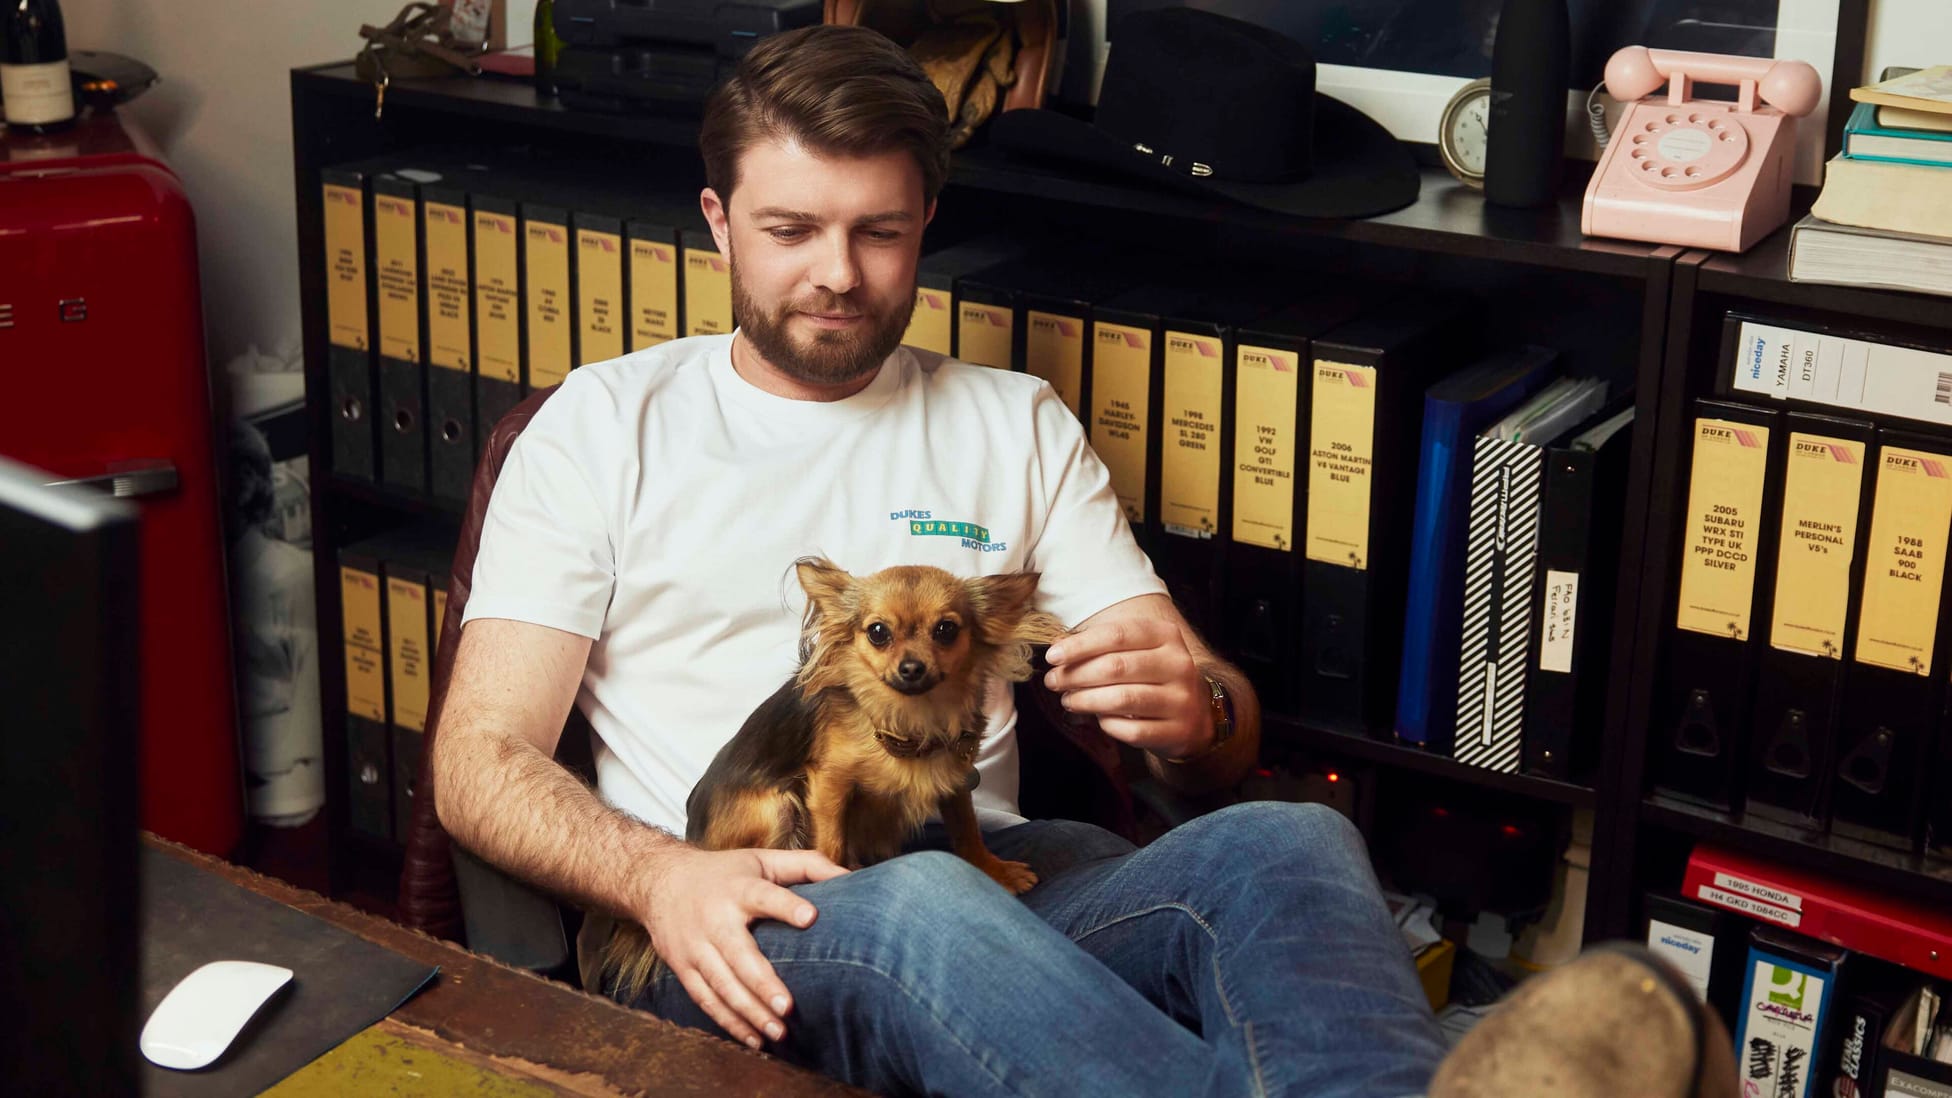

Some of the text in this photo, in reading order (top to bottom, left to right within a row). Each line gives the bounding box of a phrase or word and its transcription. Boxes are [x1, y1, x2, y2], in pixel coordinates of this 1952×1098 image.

[1170, 340, 1193, 349] DUKE
[1243, 354, 1267, 363] DUKE
[1751, 337, 1766, 380] niceday
[1776, 343, 1791, 387] YAMAHA
[1802, 350, 1814, 382] DT360
[1319, 369, 1344, 379] DUKE
[1098, 417, 1140, 431] DAVIDSON
[1171, 418, 1214, 432] MERCEDES
[1257, 425, 1276, 436] 1992
[1702, 427, 1732, 438] DUKE
[1178, 440, 1206, 451] GREEN
[1258, 436, 1273, 445] VW
[1331, 442, 1352, 452] 2006
[1254, 445, 1276, 456] GOLF
[1796, 443, 1827, 454] DUKE
[1258, 456, 1272, 465] GTI
[1312, 450, 1371, 465] ASTON MARTIN
[1886, 456, 1918, 467] DUKE
[1239, 463, 1290, 478] CONVERTIBLE
[1329, 462, 1365, 475] VANTAGE
[1255, 476, 1274, 486] BLUE
[1330, 473, 1350, 483] BLUE
[890, 509, 932, 520] DUKES
[1713, 504, 1738, 516] 2005
[1704, 514, 1745, 528] SUBARU
[1799, 519, 1842, 533] MERLIN'S
[911, 522, 988, 540] QUALITY
[1703, 525, 1744, 539] WRX STI
[1794, 530, 1844, 545] PERSONAL
[961, 538, 1007, 553] MOTORS
[1702, 536, 1742, 550] TYPE UK
[1897, 535, 1923, 548] 1988
[1694, 545, 1748, 562] PPP DCCD
[1808, 543, 1828, 554] V5's
[1894, 546, 1923, 559] SAAB
[1704, 558, 1736, 571] SILVER
[1898, 559, 1916, 569] 900
[1889, 569, 1922, 582] BLACK
[1727, 879, 1789, 904] 1995 HONDA
[1710, 890, 1724, 901] H4
[1726, 895, 1749, 909] GKD
[1848, 1015, 1867, 1079] CLASSICS
